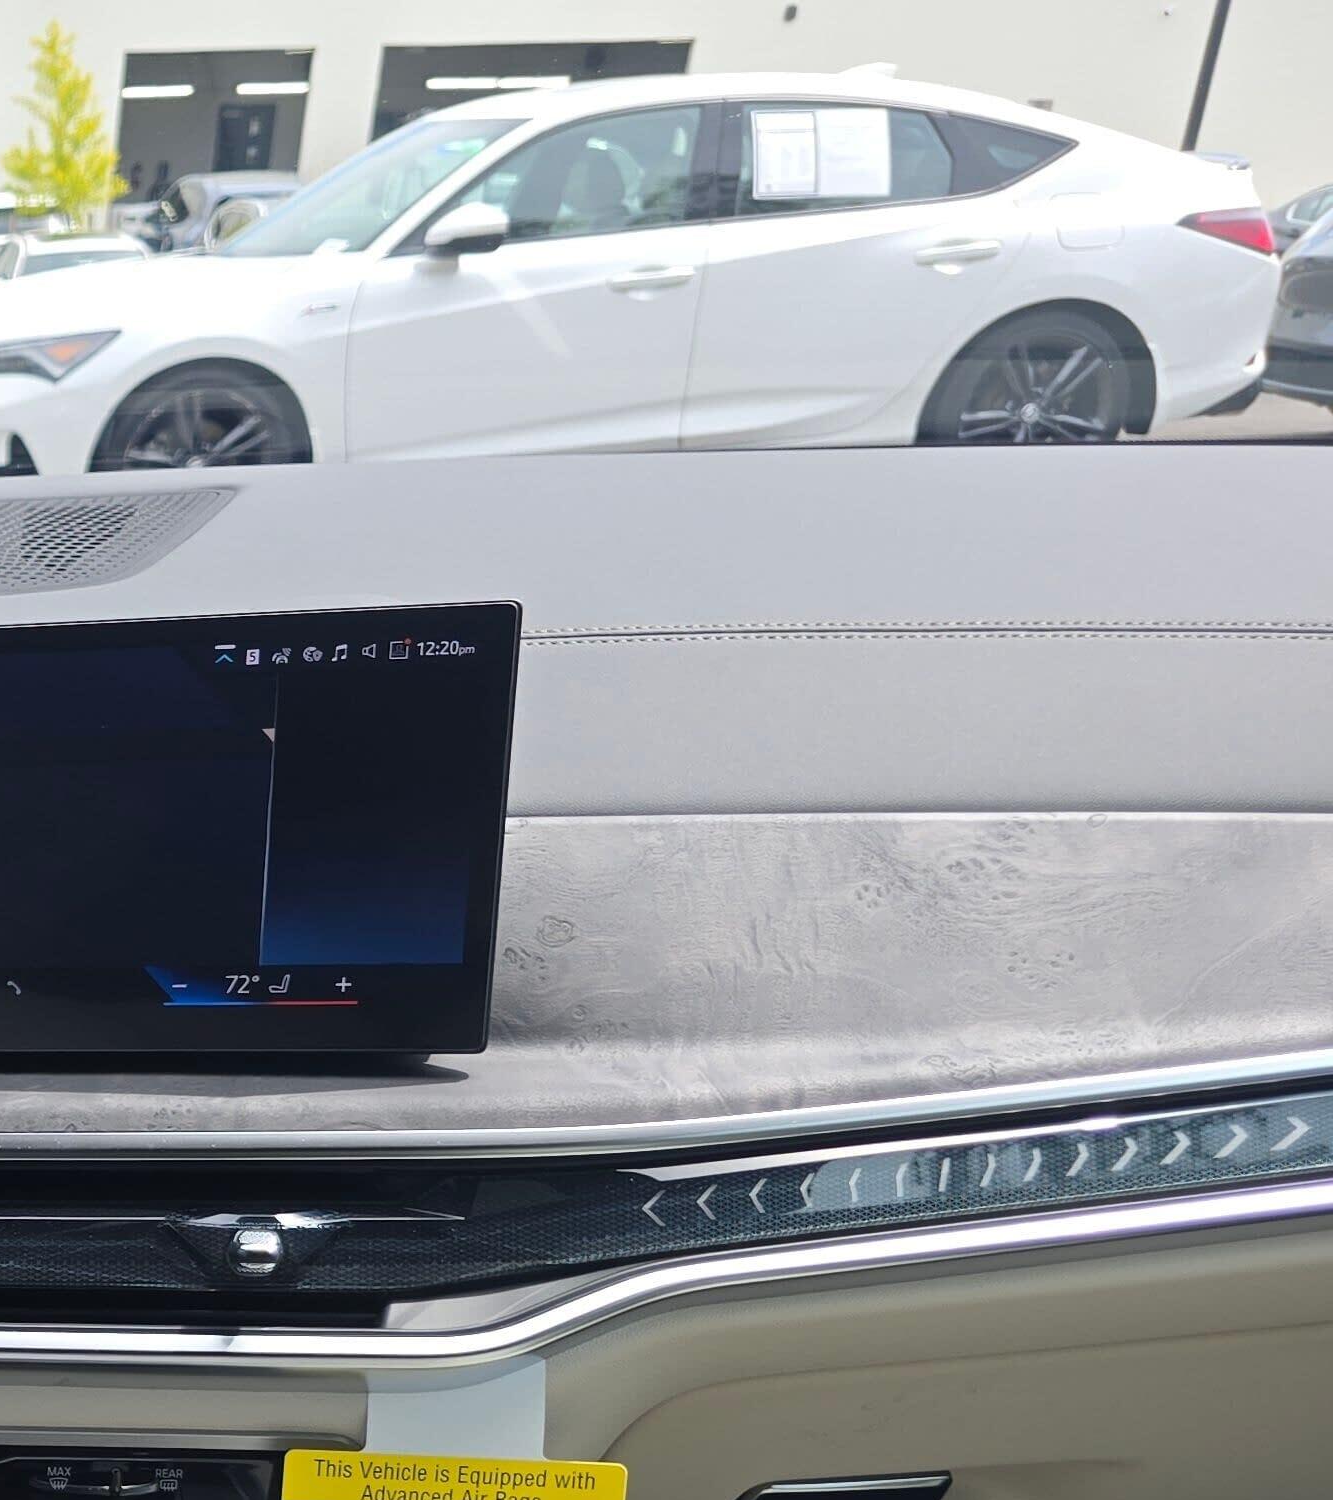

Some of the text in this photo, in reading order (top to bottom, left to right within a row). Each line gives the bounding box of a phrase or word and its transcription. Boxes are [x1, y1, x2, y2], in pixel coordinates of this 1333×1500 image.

[47, 1466, 71, 1476] MAX
[155, 1468, 183, 1479] REAR
[314, 1459, 595, 1490] This Vehicle is Equipped with
